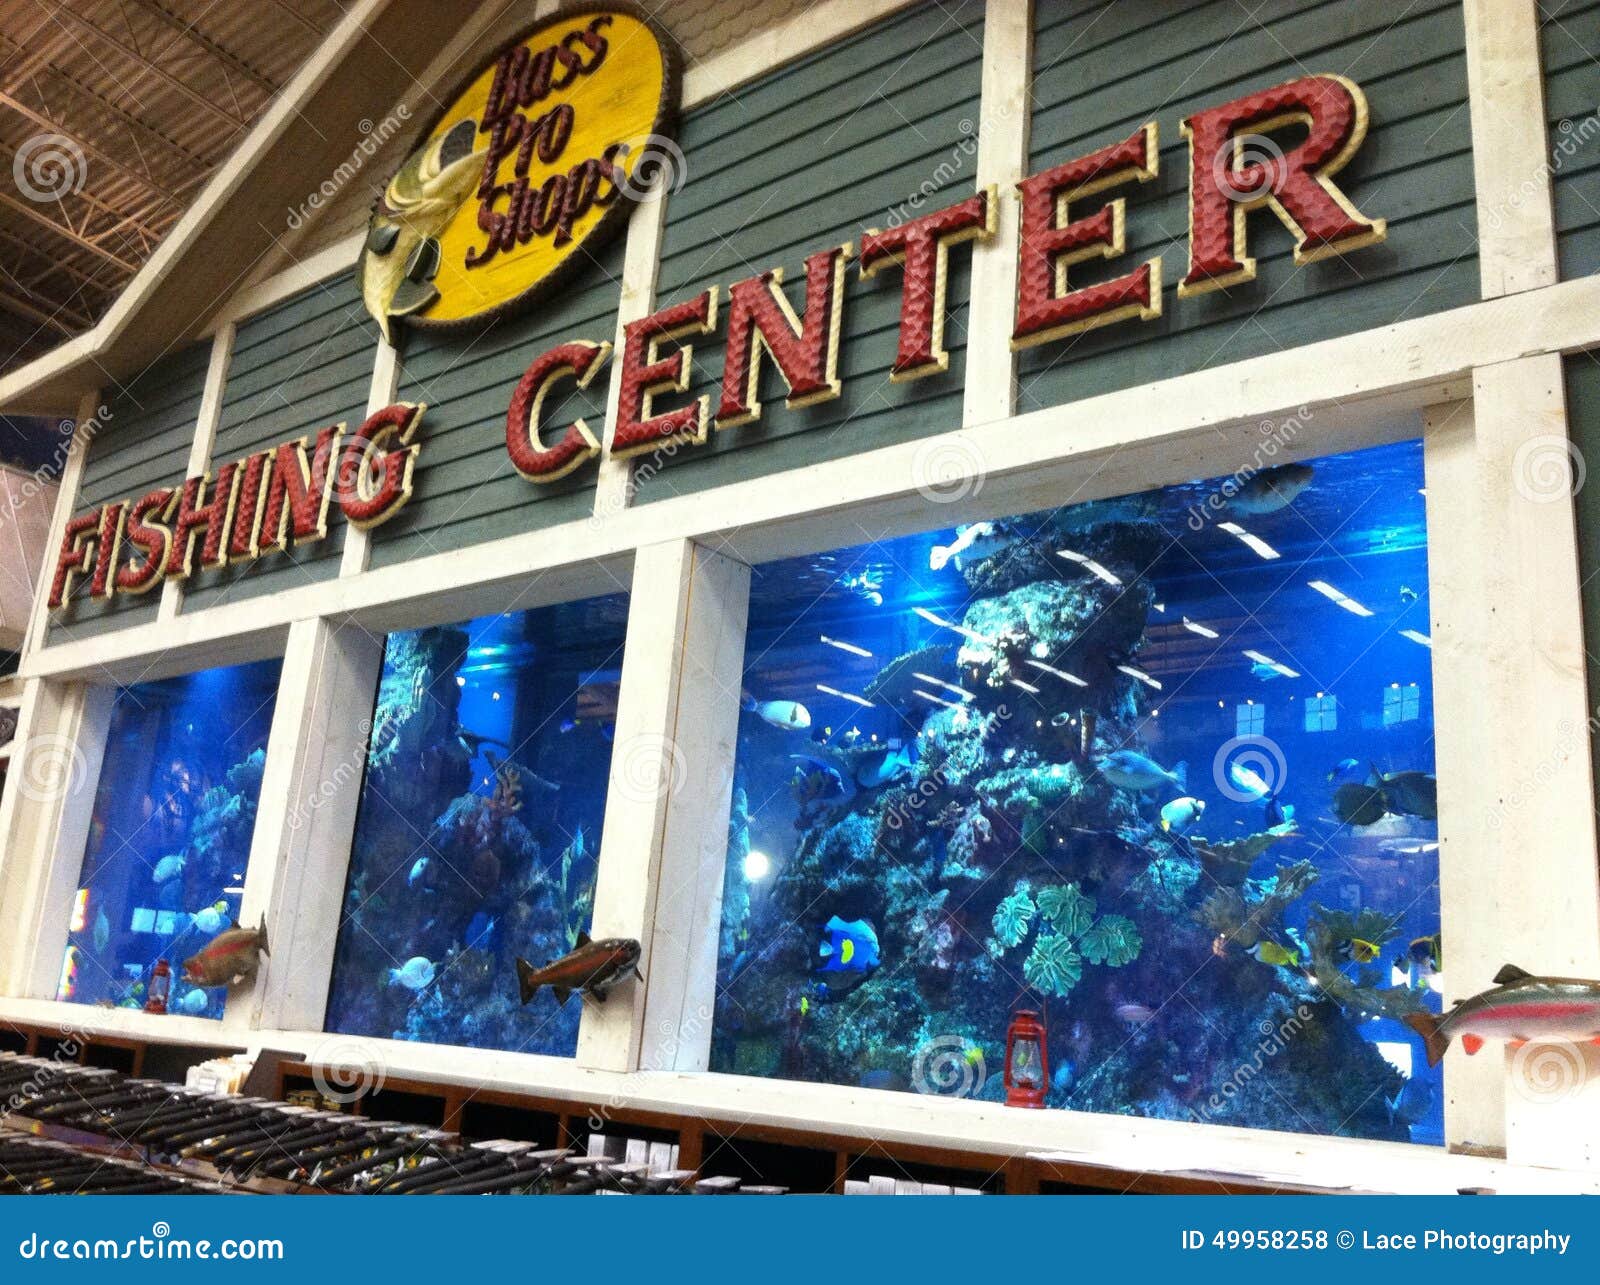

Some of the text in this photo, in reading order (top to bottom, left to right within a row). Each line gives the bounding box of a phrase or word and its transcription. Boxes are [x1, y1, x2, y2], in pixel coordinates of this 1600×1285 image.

[480, 16, 613, 133] Bass
[465, 142, 630, 271] Shops
[477, 104, 575, 200] Pro
[48, 73, 1387, 611] FISHING CENTER
